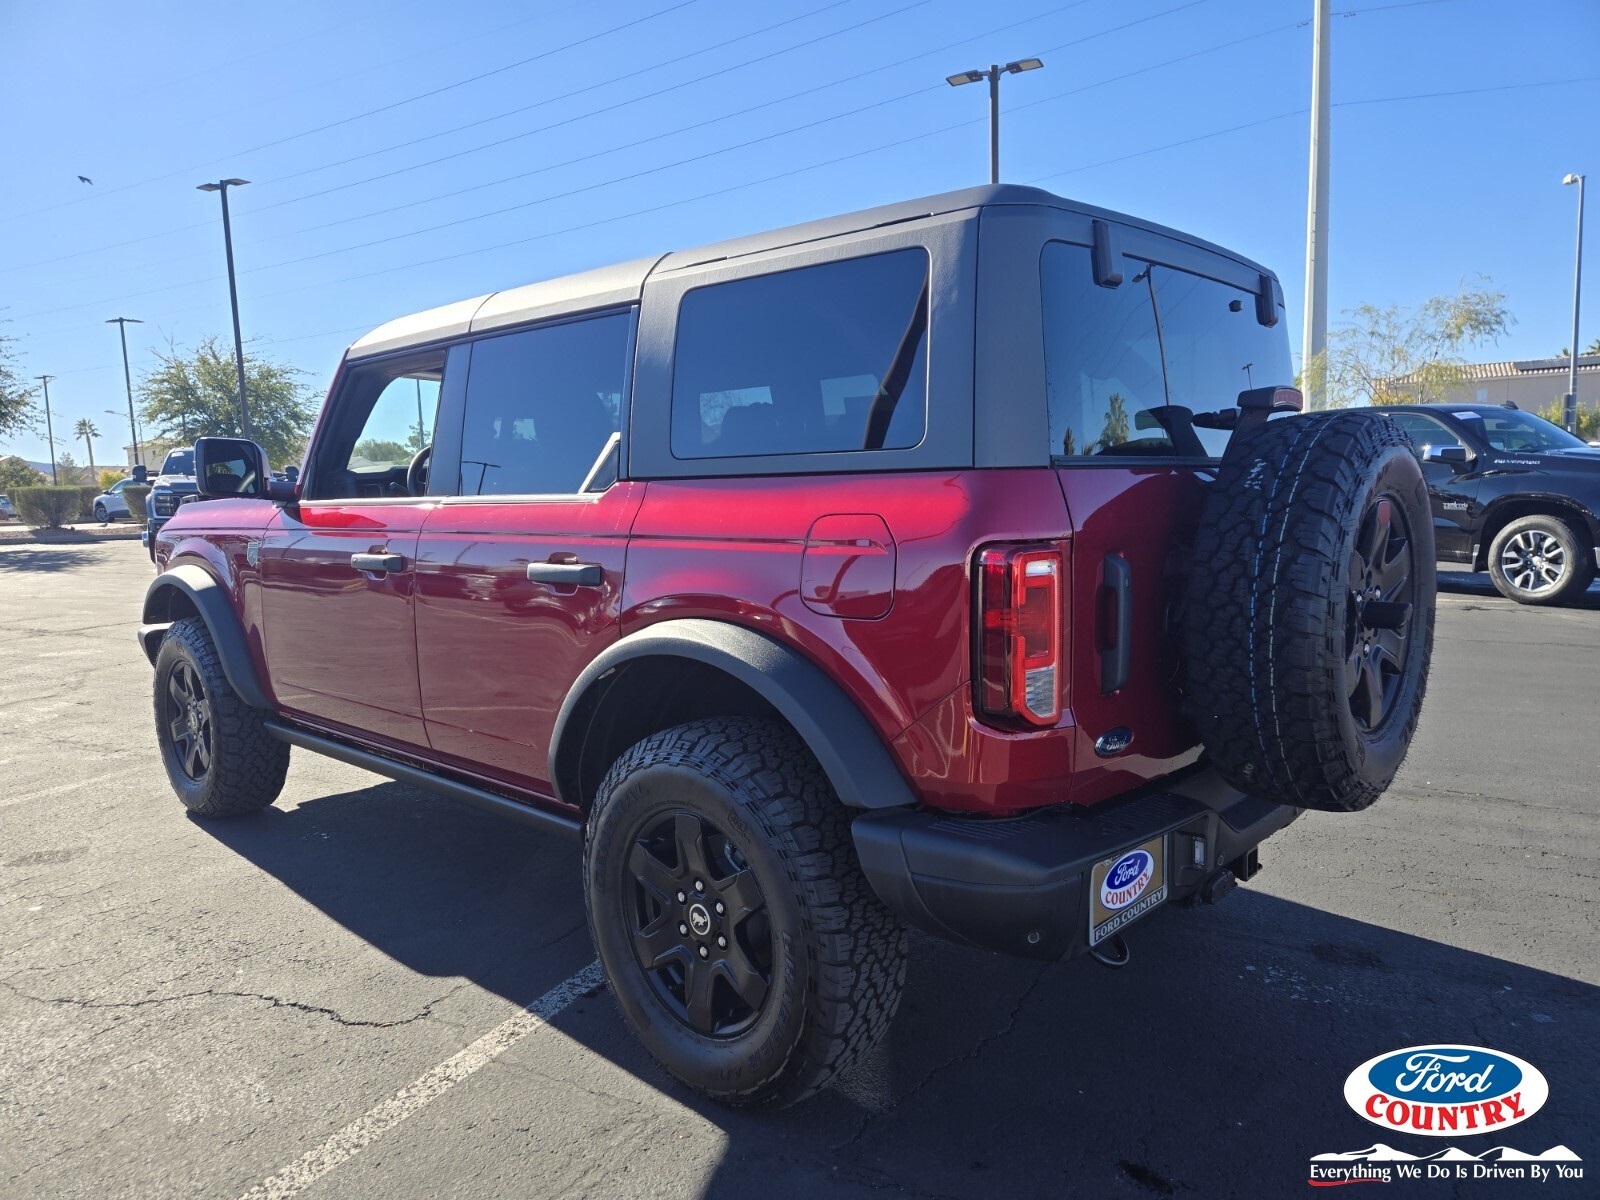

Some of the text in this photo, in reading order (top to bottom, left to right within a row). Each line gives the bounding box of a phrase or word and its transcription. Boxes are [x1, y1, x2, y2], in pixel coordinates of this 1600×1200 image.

[1105, 868, 1150, 905] COUNTRY
[1114, 857, 1141, 886] Ford
[1095, 890, 1164, 941] FORD COUNTRY
